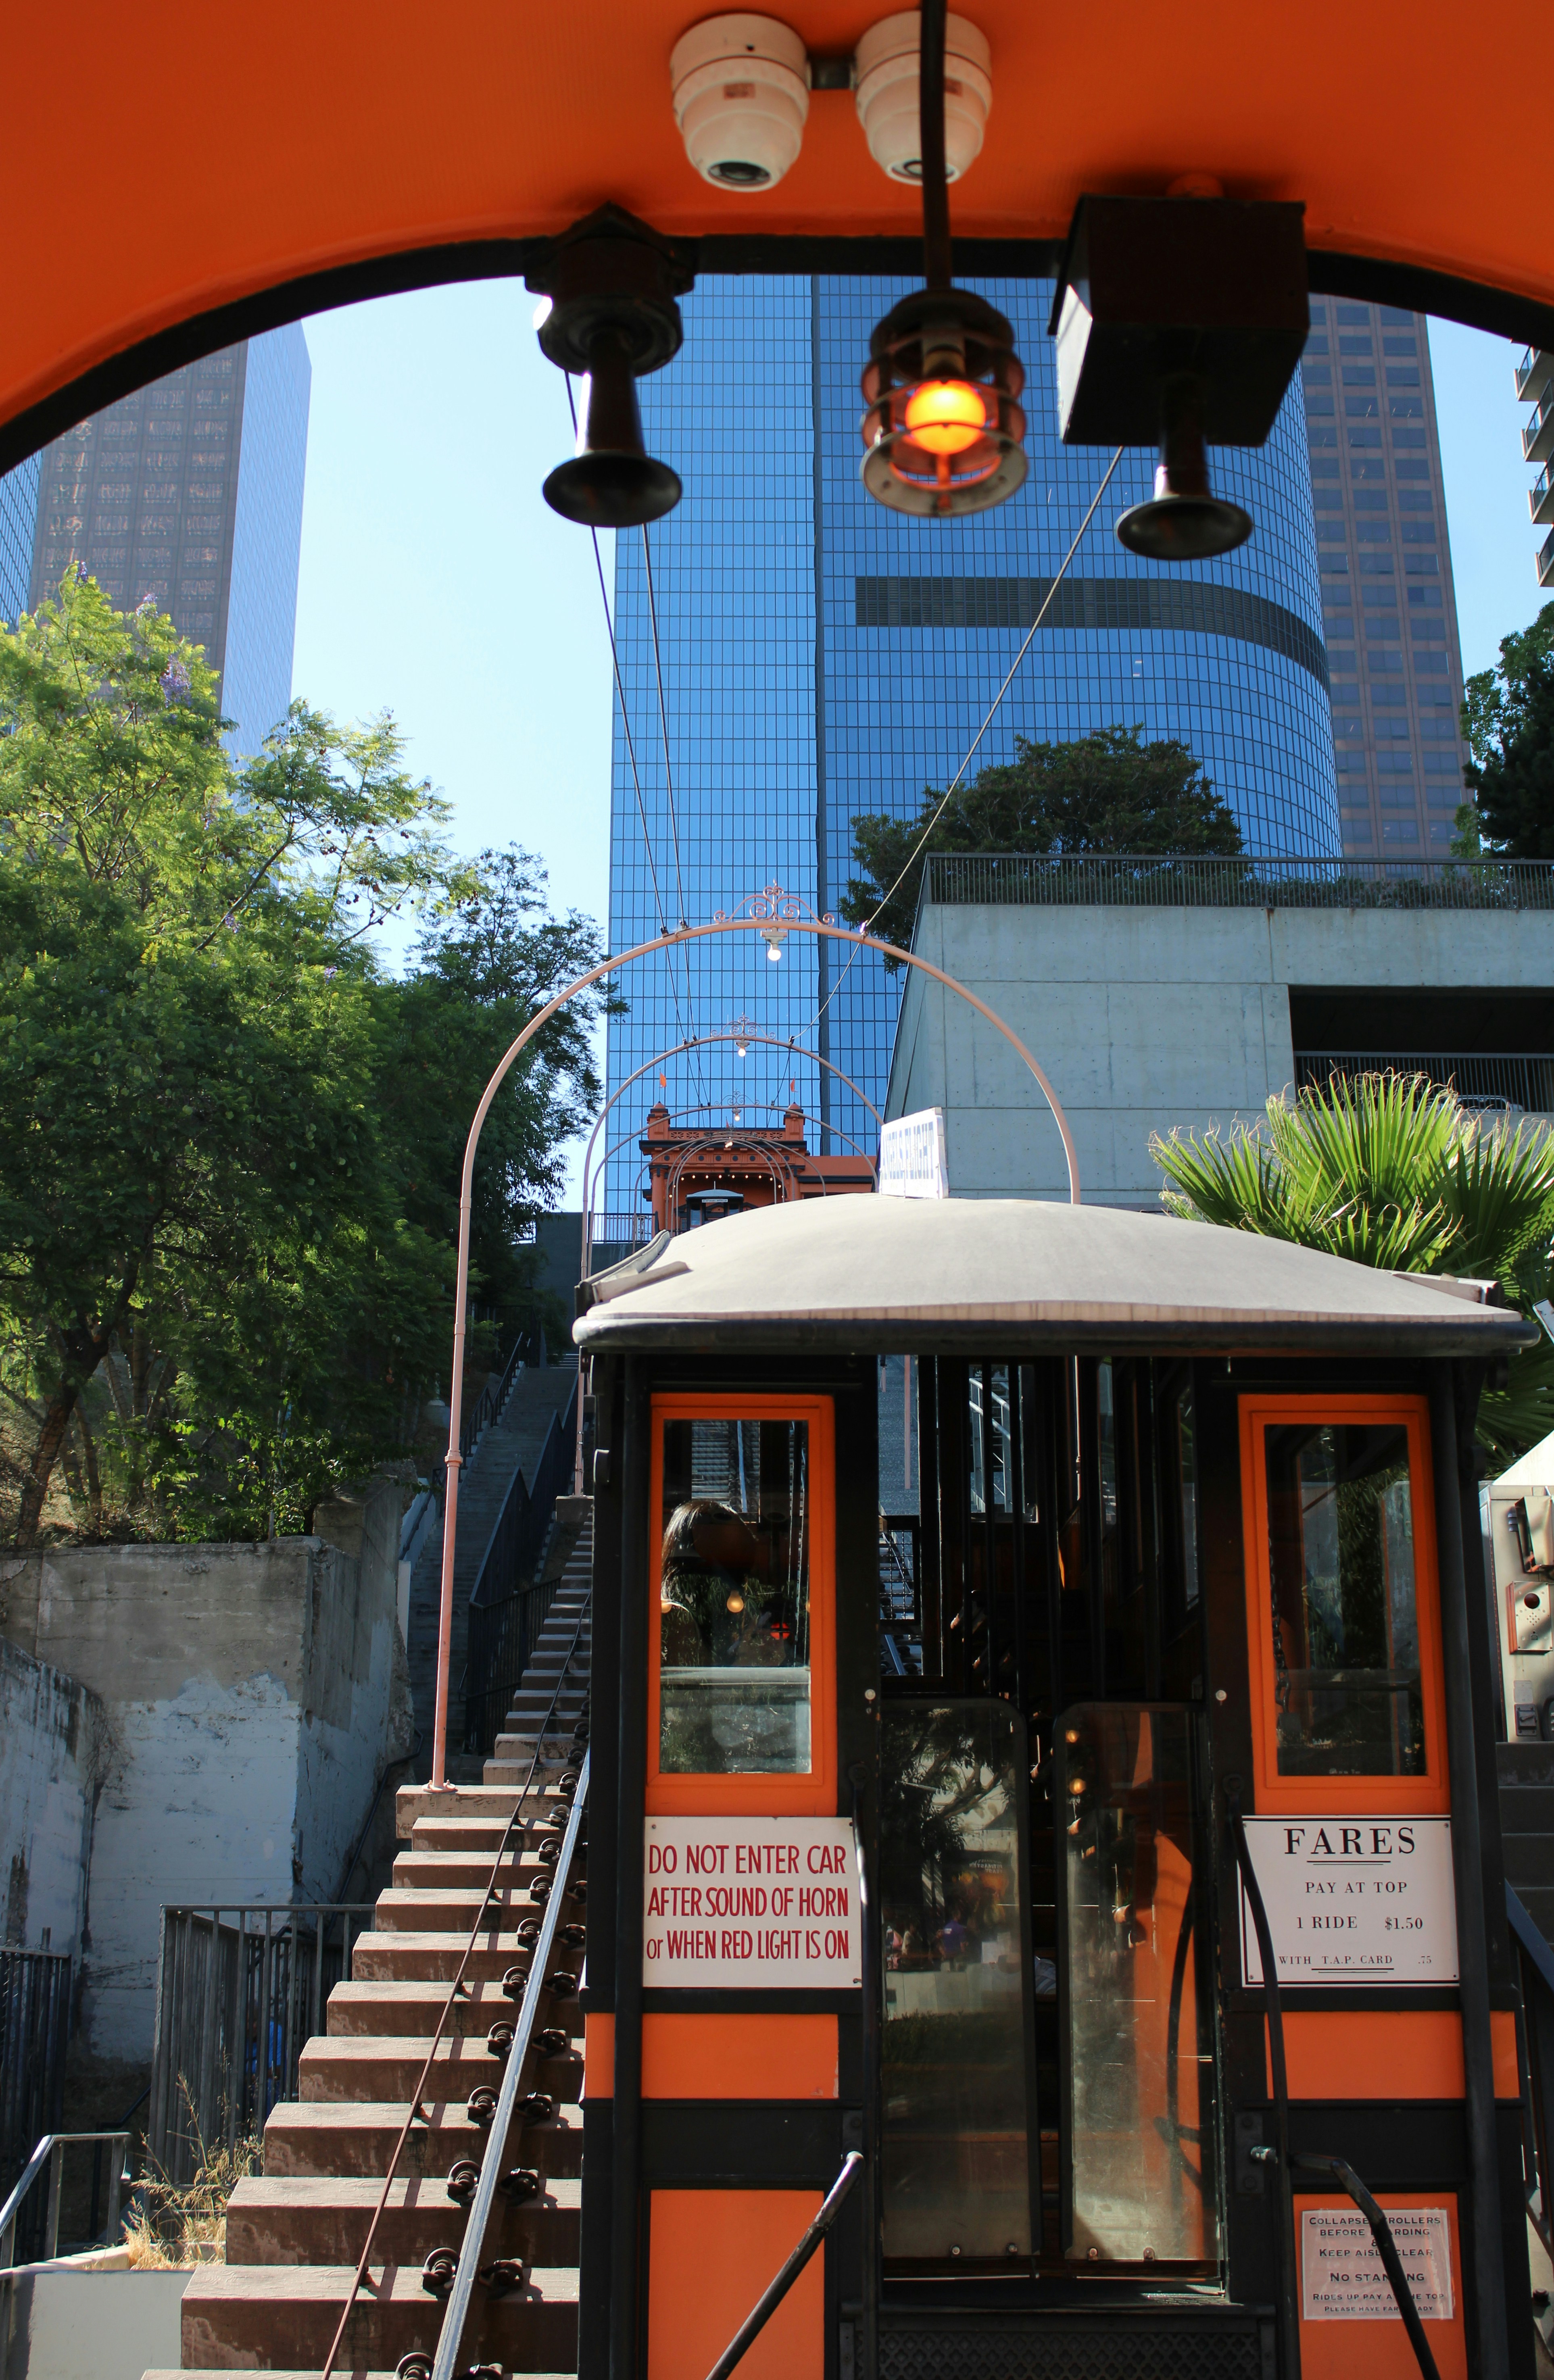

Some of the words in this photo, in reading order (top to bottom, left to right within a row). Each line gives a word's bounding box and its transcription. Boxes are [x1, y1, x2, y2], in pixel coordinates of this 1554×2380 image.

[882, 1130, 903, 1180] ANGELS
[905, 1121, 934, 1180] FLIGHT
[1284, 1827, 1416, 1855] FARES
[649, 1844, 678, 1874] DO
[686, 1845, 729, 1874] NOT
[736, 1845, 799, 1874] ENTER
[807, 1845, 846, 1874] CAR
[1305, 1882, 1336, 1893] PAY
[1344, 1882, 1366, 1893] AT
[1373, 1882, 1407, 1893] TOP
[647, 1887, 702, 1916] AFTER
[705, 1887, 767, 1917] SOUND
[772, 1887, 794, 1916] OF
[799, 1888, 849, 1916] HORN
[1296, 1916, 1304, 1928] 1
[1311, 1916, 1358, 1929] RIDE
[1384, 1916, 1423, 1931] $1.50
[647, 1938, 663, 1959] or
[667, 1930, 716, 1959] WHEN
[721, 1930, 753, 1959] RED
[757, 1930, 802, 1959] LIGHT
[806, 1930, 821, 1959] IS
[824, 1930, 849, 1959] ON
[1279, 1956, 1312, 1964] WITH
[1322, 1955, 1355, 1964] T.A.P.
[1360, 1955, 1392, 1964] CARD
[1418, 1956, 1431, 1964] .75
[1319, 2249, 1350, 2257] KEEP
[1330, 2273, 1350, 2282] NO
[1355, 2273, 1425, 2281] STANNG
